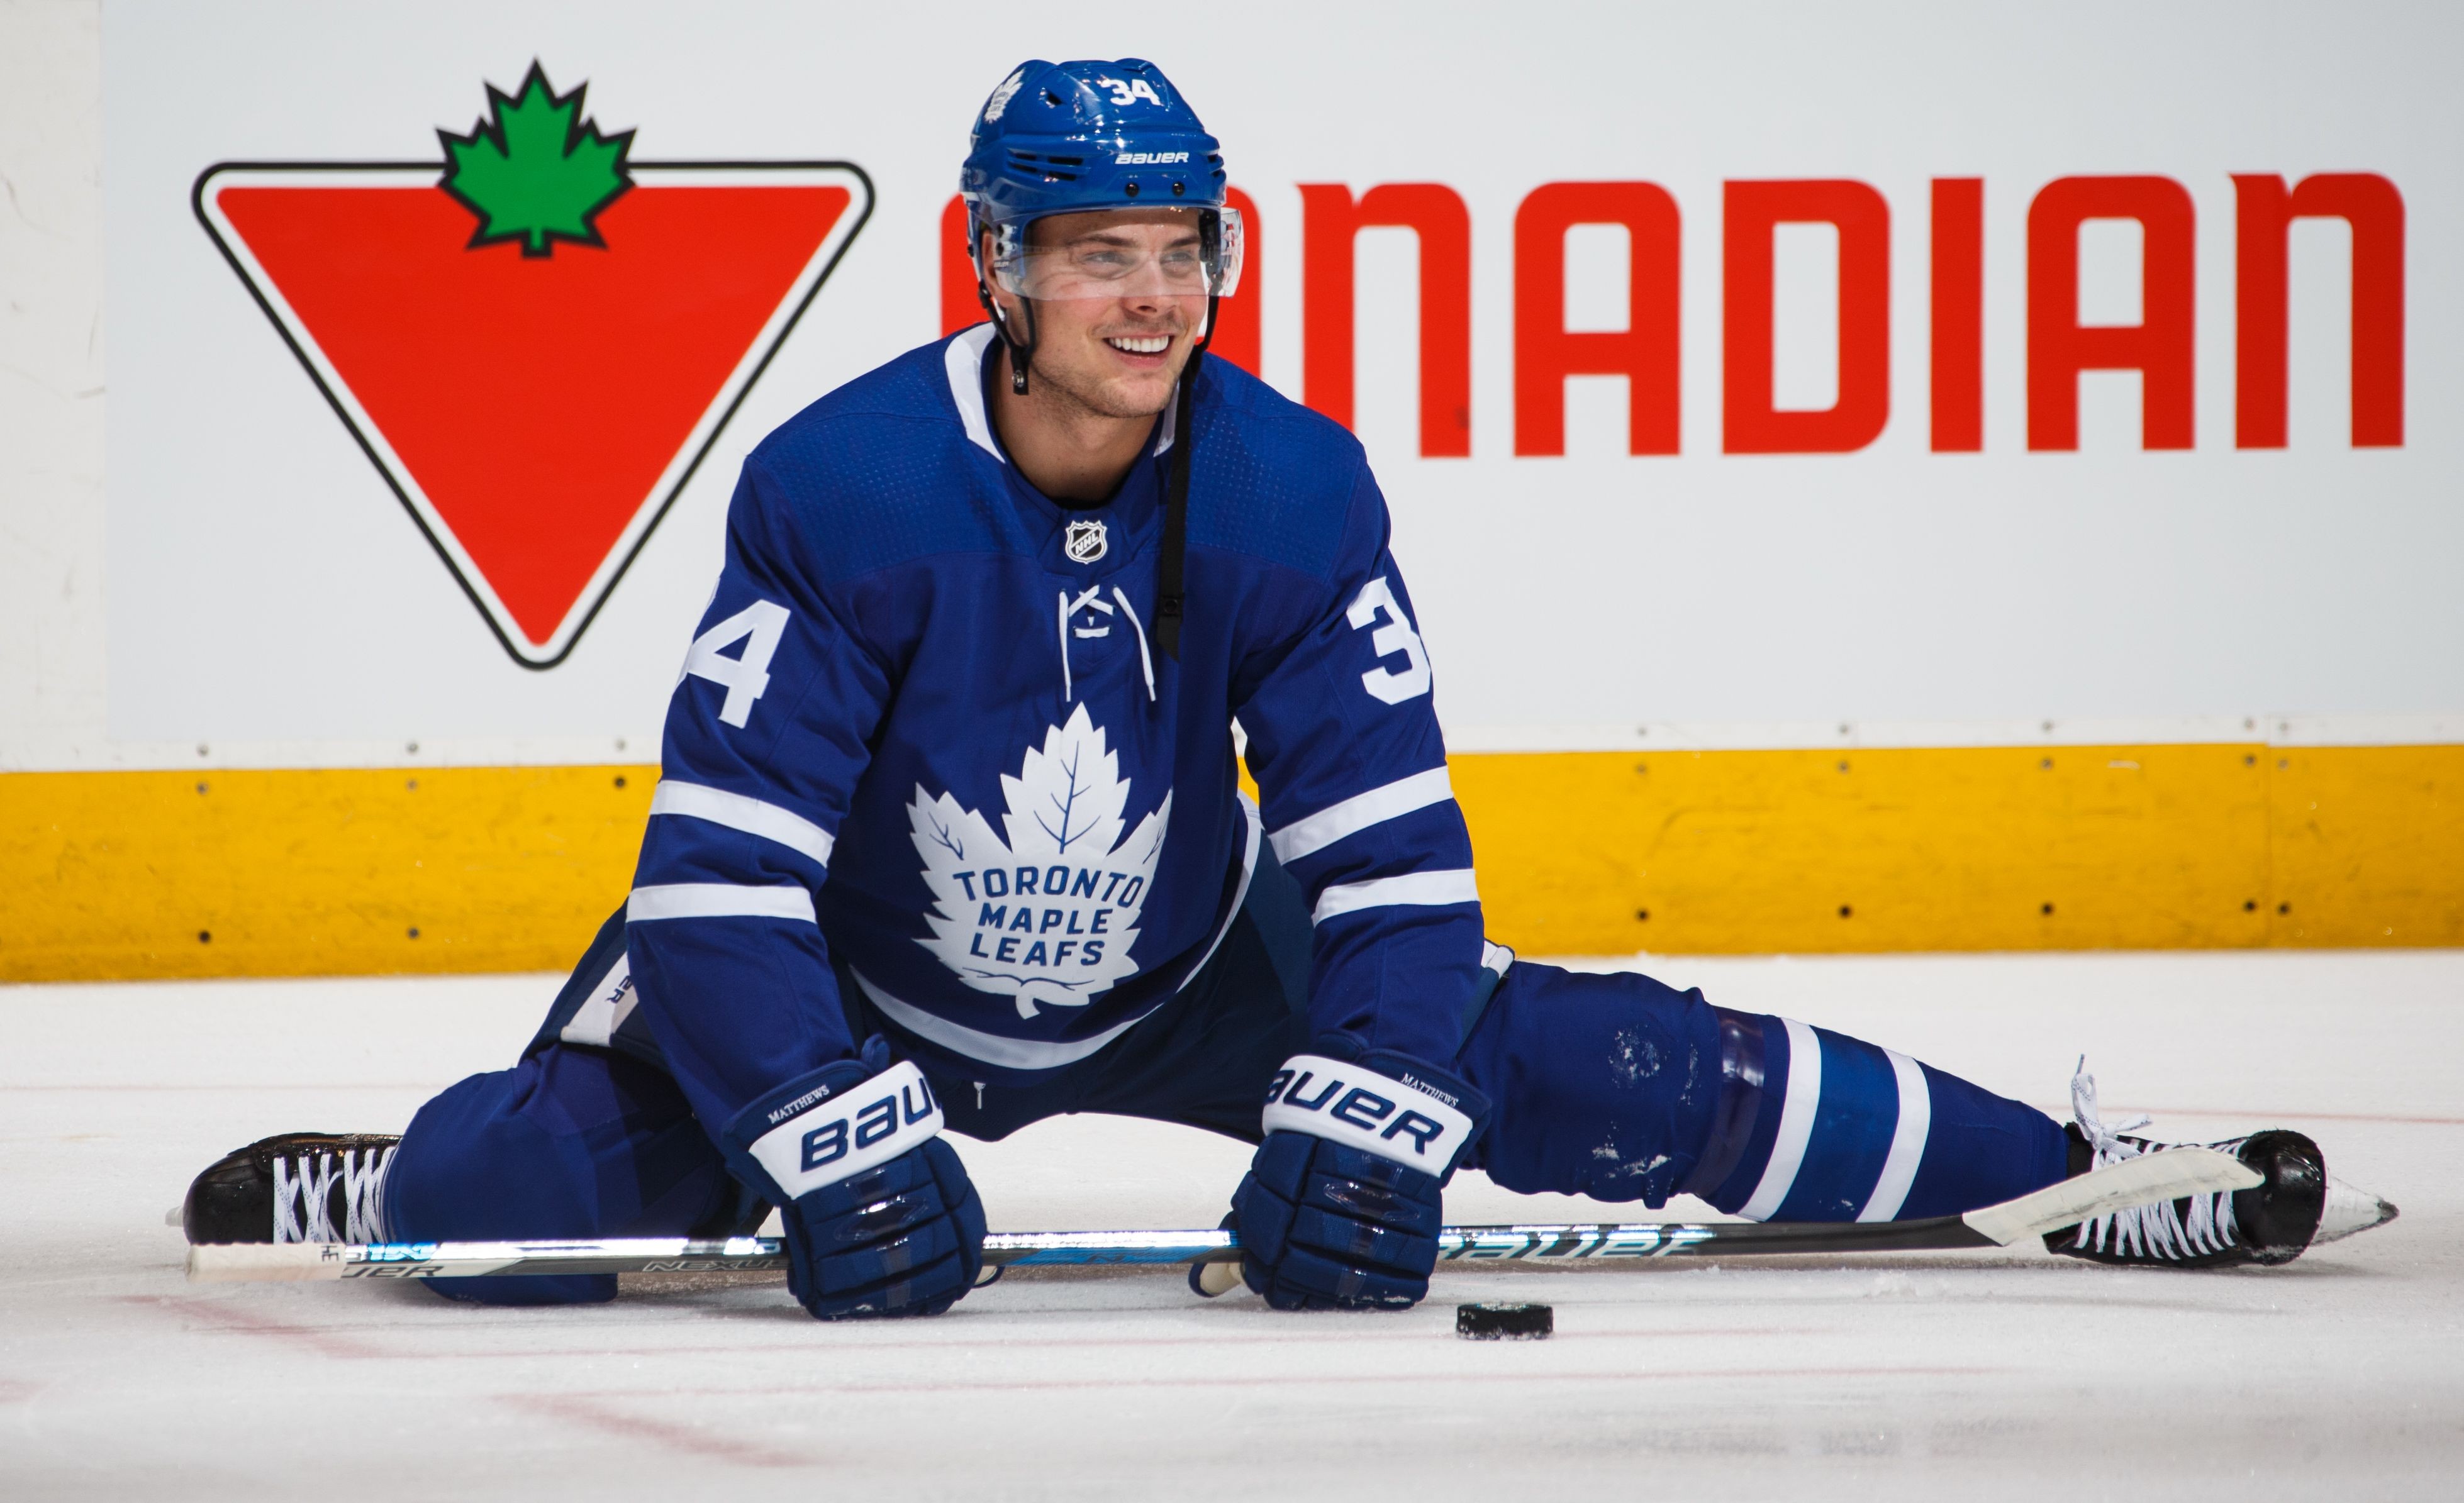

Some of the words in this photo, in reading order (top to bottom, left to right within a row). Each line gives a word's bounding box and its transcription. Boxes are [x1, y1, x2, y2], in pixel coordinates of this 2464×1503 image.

[1104, 79, 1161, 106] 34
[1115, 151, 1190, 165] BAUER
[940, 170, 2407, 459] NADIAN
[1074, 531, 1100, 555] NHL
[679, 579, 791, 729] 4
[952, 865, 1145, 909] TORONTO
[978, 902, 1113, 935] MAPLE
[969, 932, 1106, 967] LEAFS
[767, 1084, 830, 1124] MATTHEWS
[1401, 1072, 1459, 1108] MATTHEWS
[801, 1077, 941, 1173] BAU
[1264, 1068, 1445, 1156] AUER
